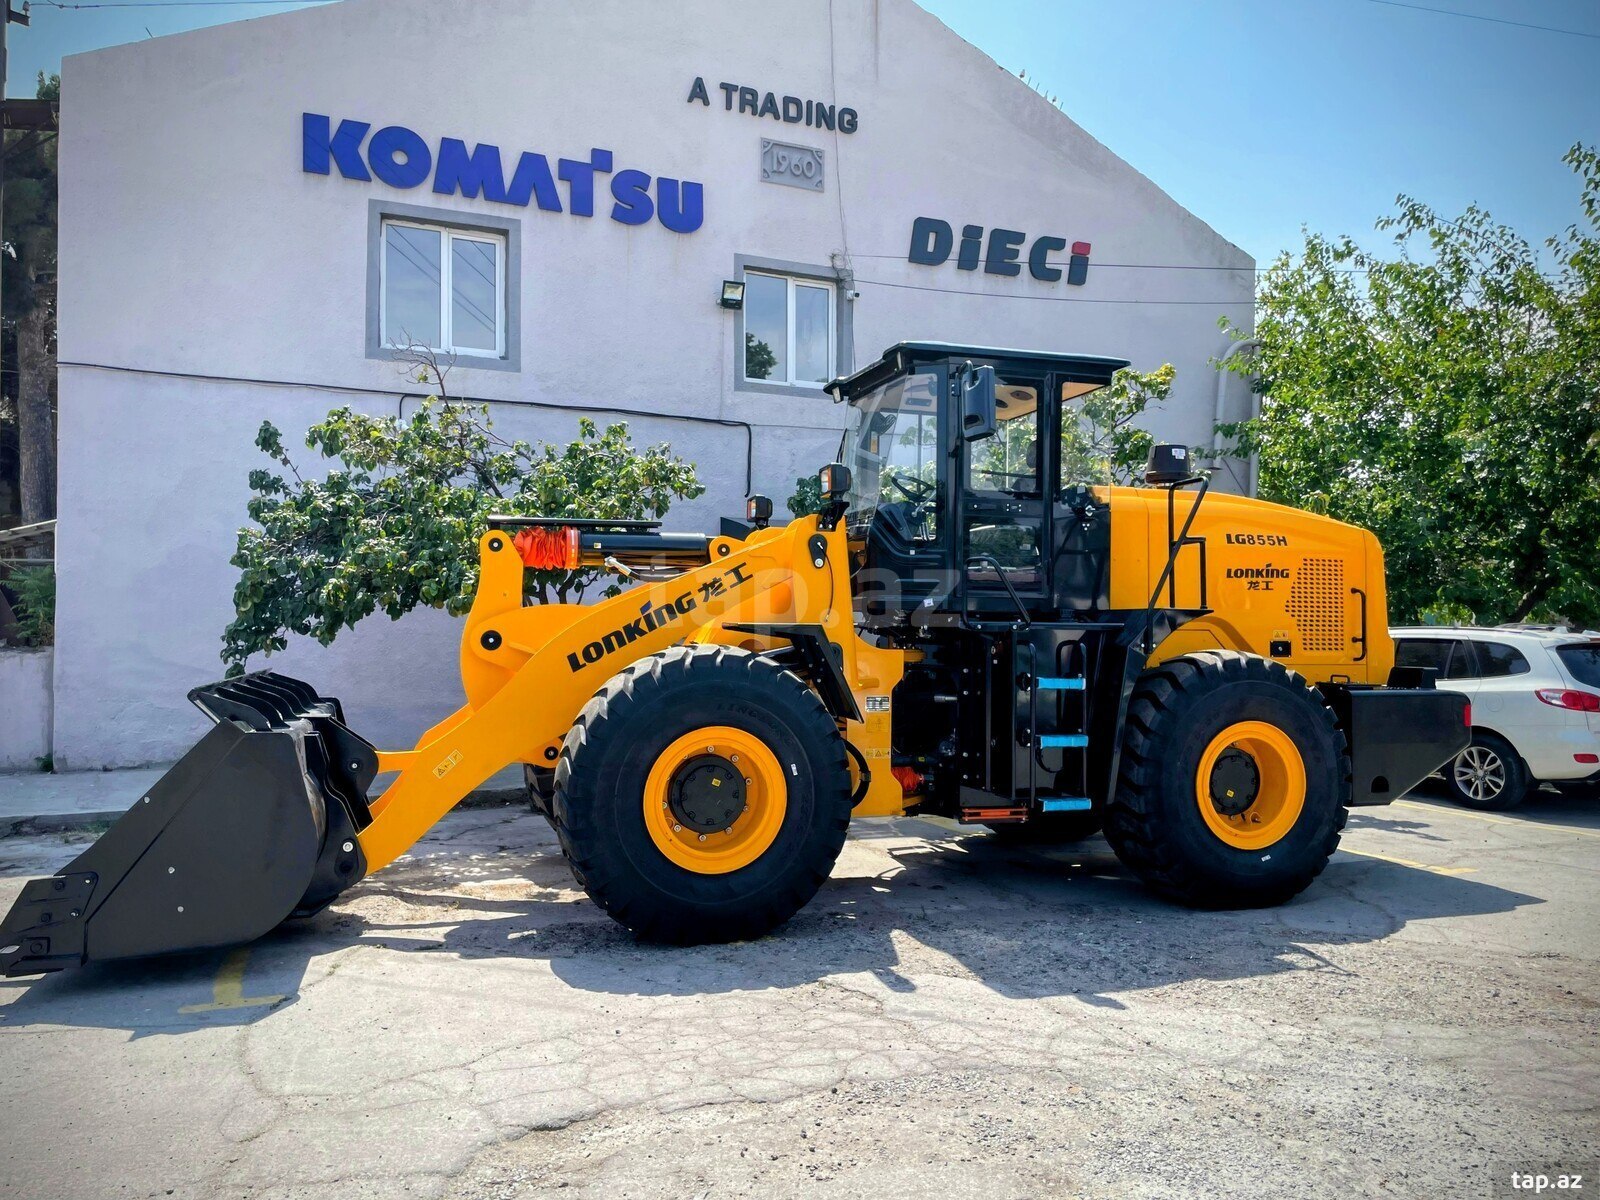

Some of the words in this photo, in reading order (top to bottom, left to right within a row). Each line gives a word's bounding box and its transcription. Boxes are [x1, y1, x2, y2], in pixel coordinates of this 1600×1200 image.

[687, 77, 710, 106] A
[719, 82, 858, 134] TRADING
[302, 112, 704, 233] KOMATSU
[771, 151, 816, 178] 1960
[1226, 533, 1288, 547] LG855H
[698, 562, 753, 602] 龙工
[1247, 580, 1274, 591] 龙工
